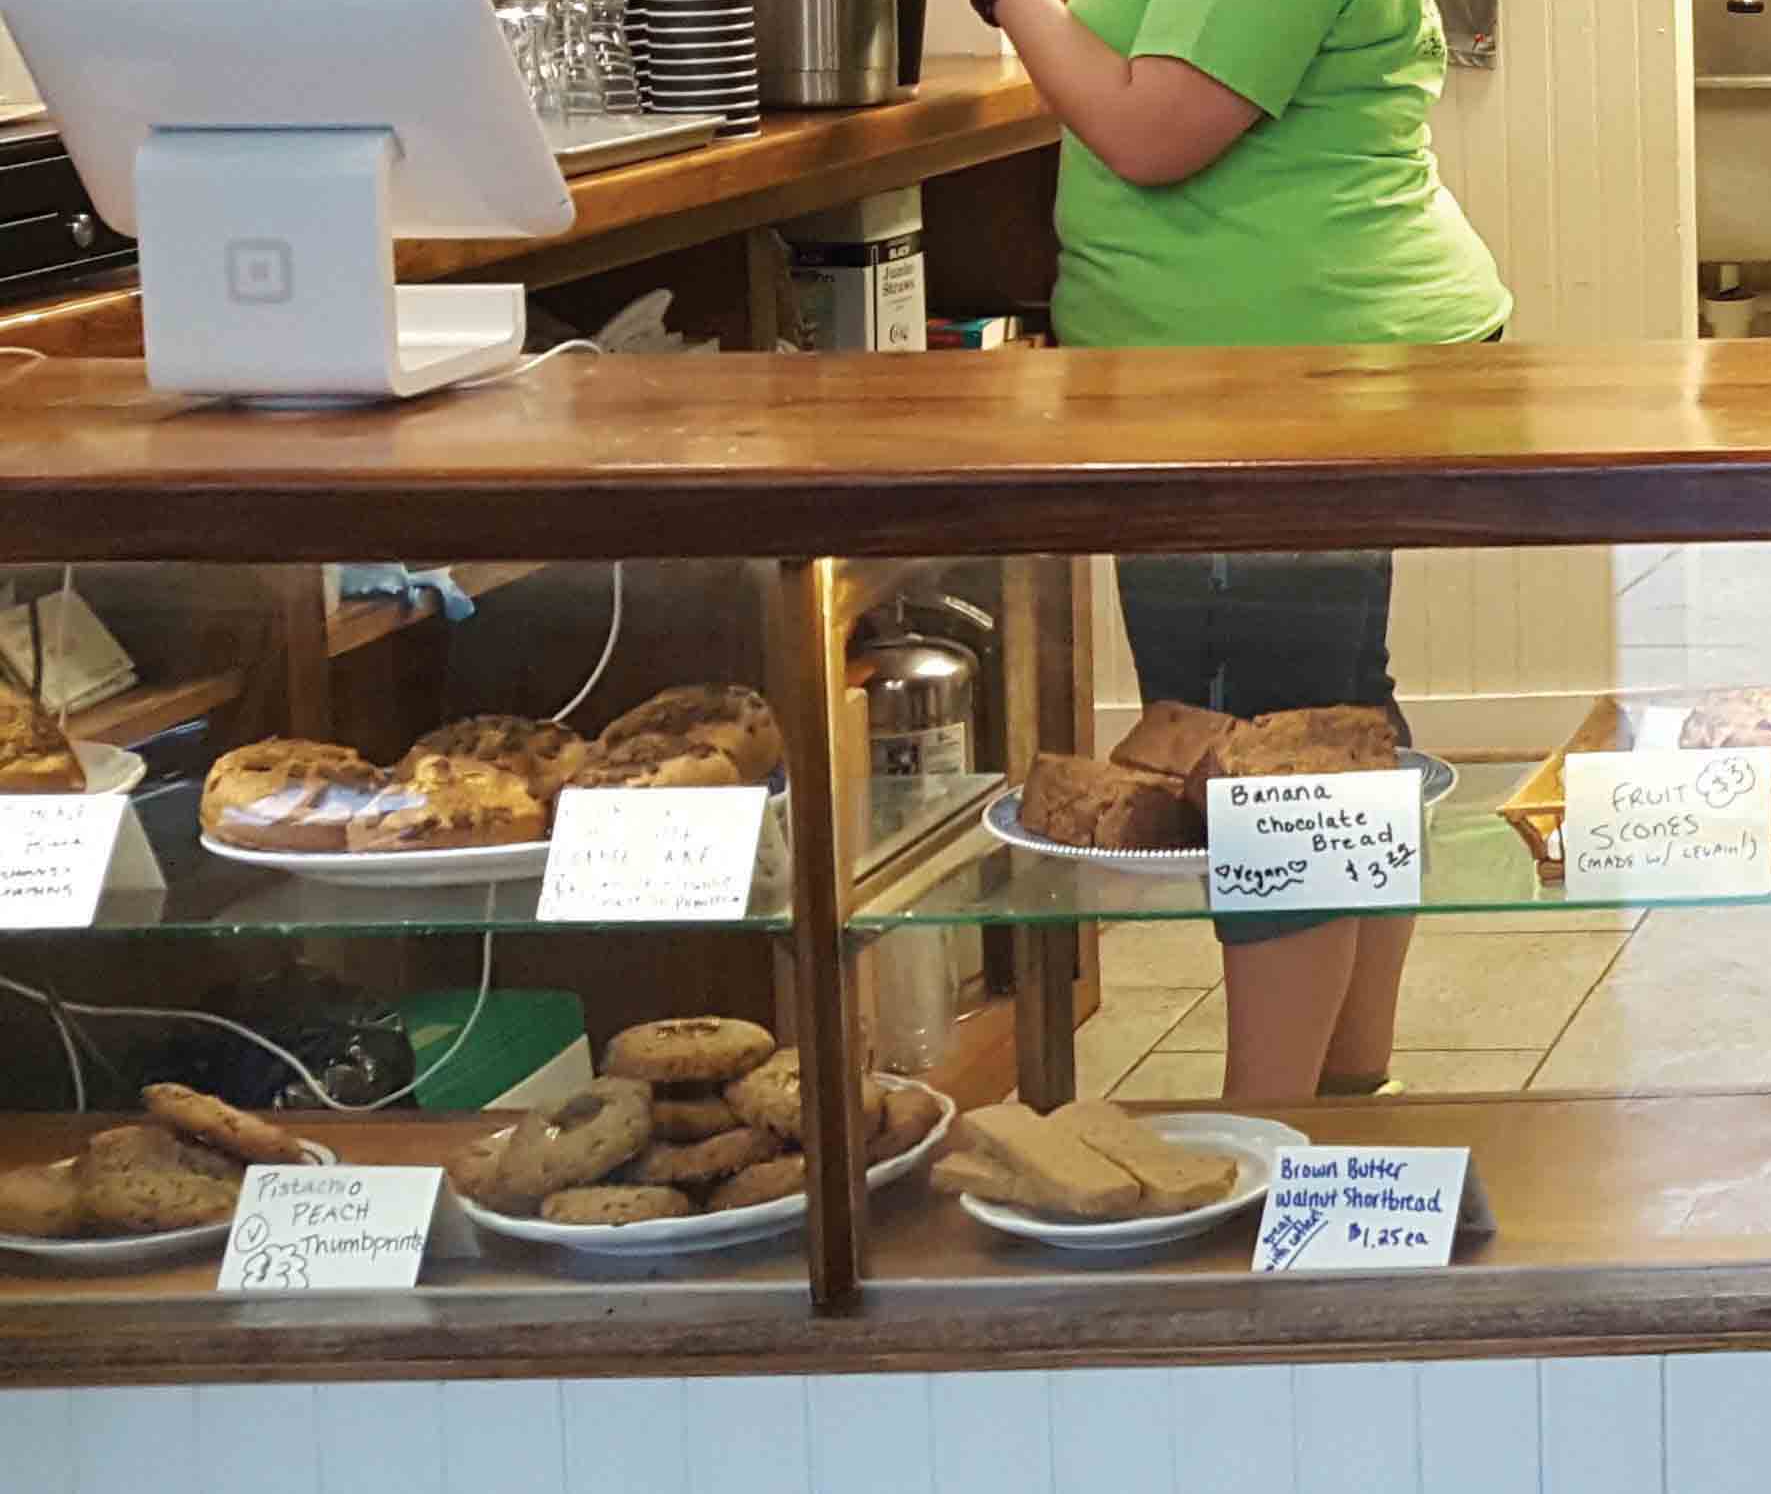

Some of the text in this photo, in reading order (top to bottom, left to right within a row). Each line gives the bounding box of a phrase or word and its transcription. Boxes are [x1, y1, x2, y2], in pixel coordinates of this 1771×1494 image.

[1230, 783, 1333, 807] Banana
[1611, 780, 1688, 815] FRUIT
[1312, 822, 1395, 854] Bread
[1279, 1156, 1409, 1182] Brown Butter
[256, 1171, 364, 1204] Pistachio
[1342, 1186, 1444, 1214] Shortbread
[291, 1202, 370, 1228] PEACH
[1348, 1222, 1431, 1251] $1.25 ea
